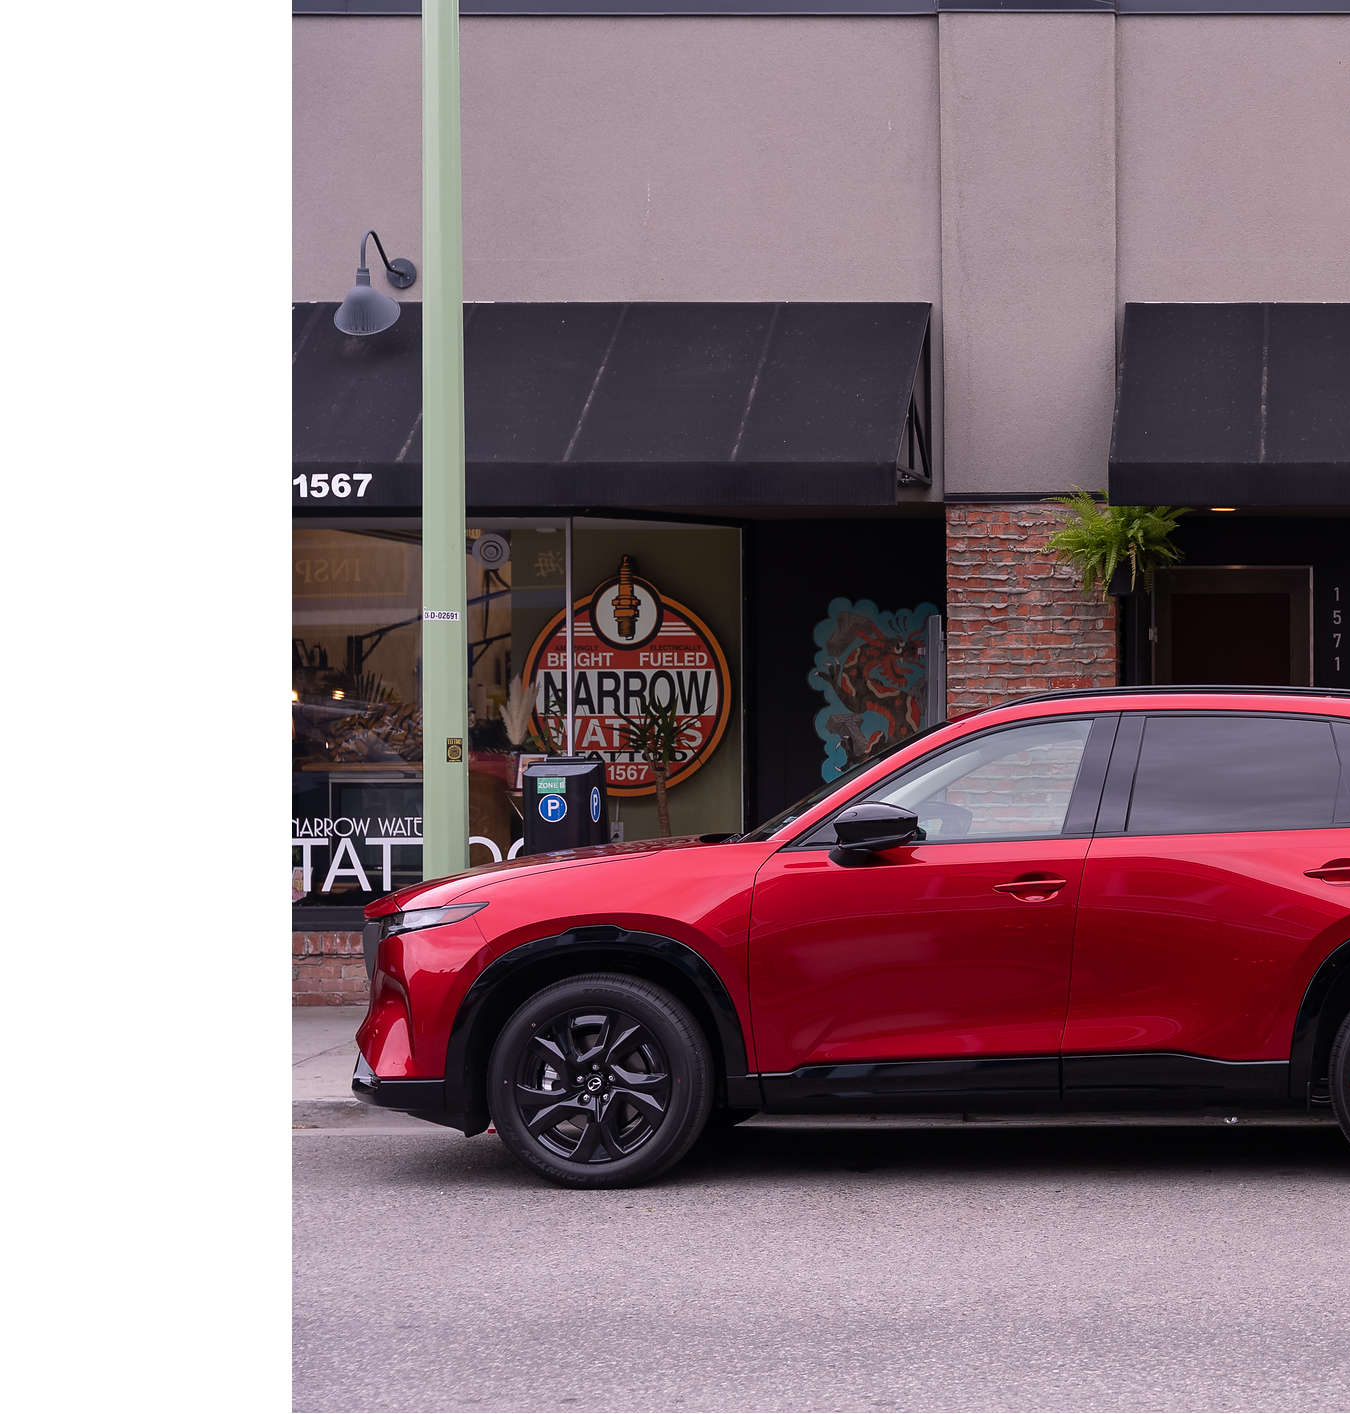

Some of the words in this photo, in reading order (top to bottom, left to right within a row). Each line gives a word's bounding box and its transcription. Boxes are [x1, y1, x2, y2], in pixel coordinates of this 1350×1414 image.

[293, 473, 373, 498] 1567
[1333, 587, 1341, 671] 1571
[639, 652, 708, 667] FUELED
[543, 670, 712, 714] NARROW
[608, 766, 649, 780] 1567
[560, 781, 566, 789] B
[547, 800, 560, 817] P
[593, 794, 599, 816] P
[377, 817, 423, 837] WATE
[521, 1149, 589, 1182] COUNTRY
